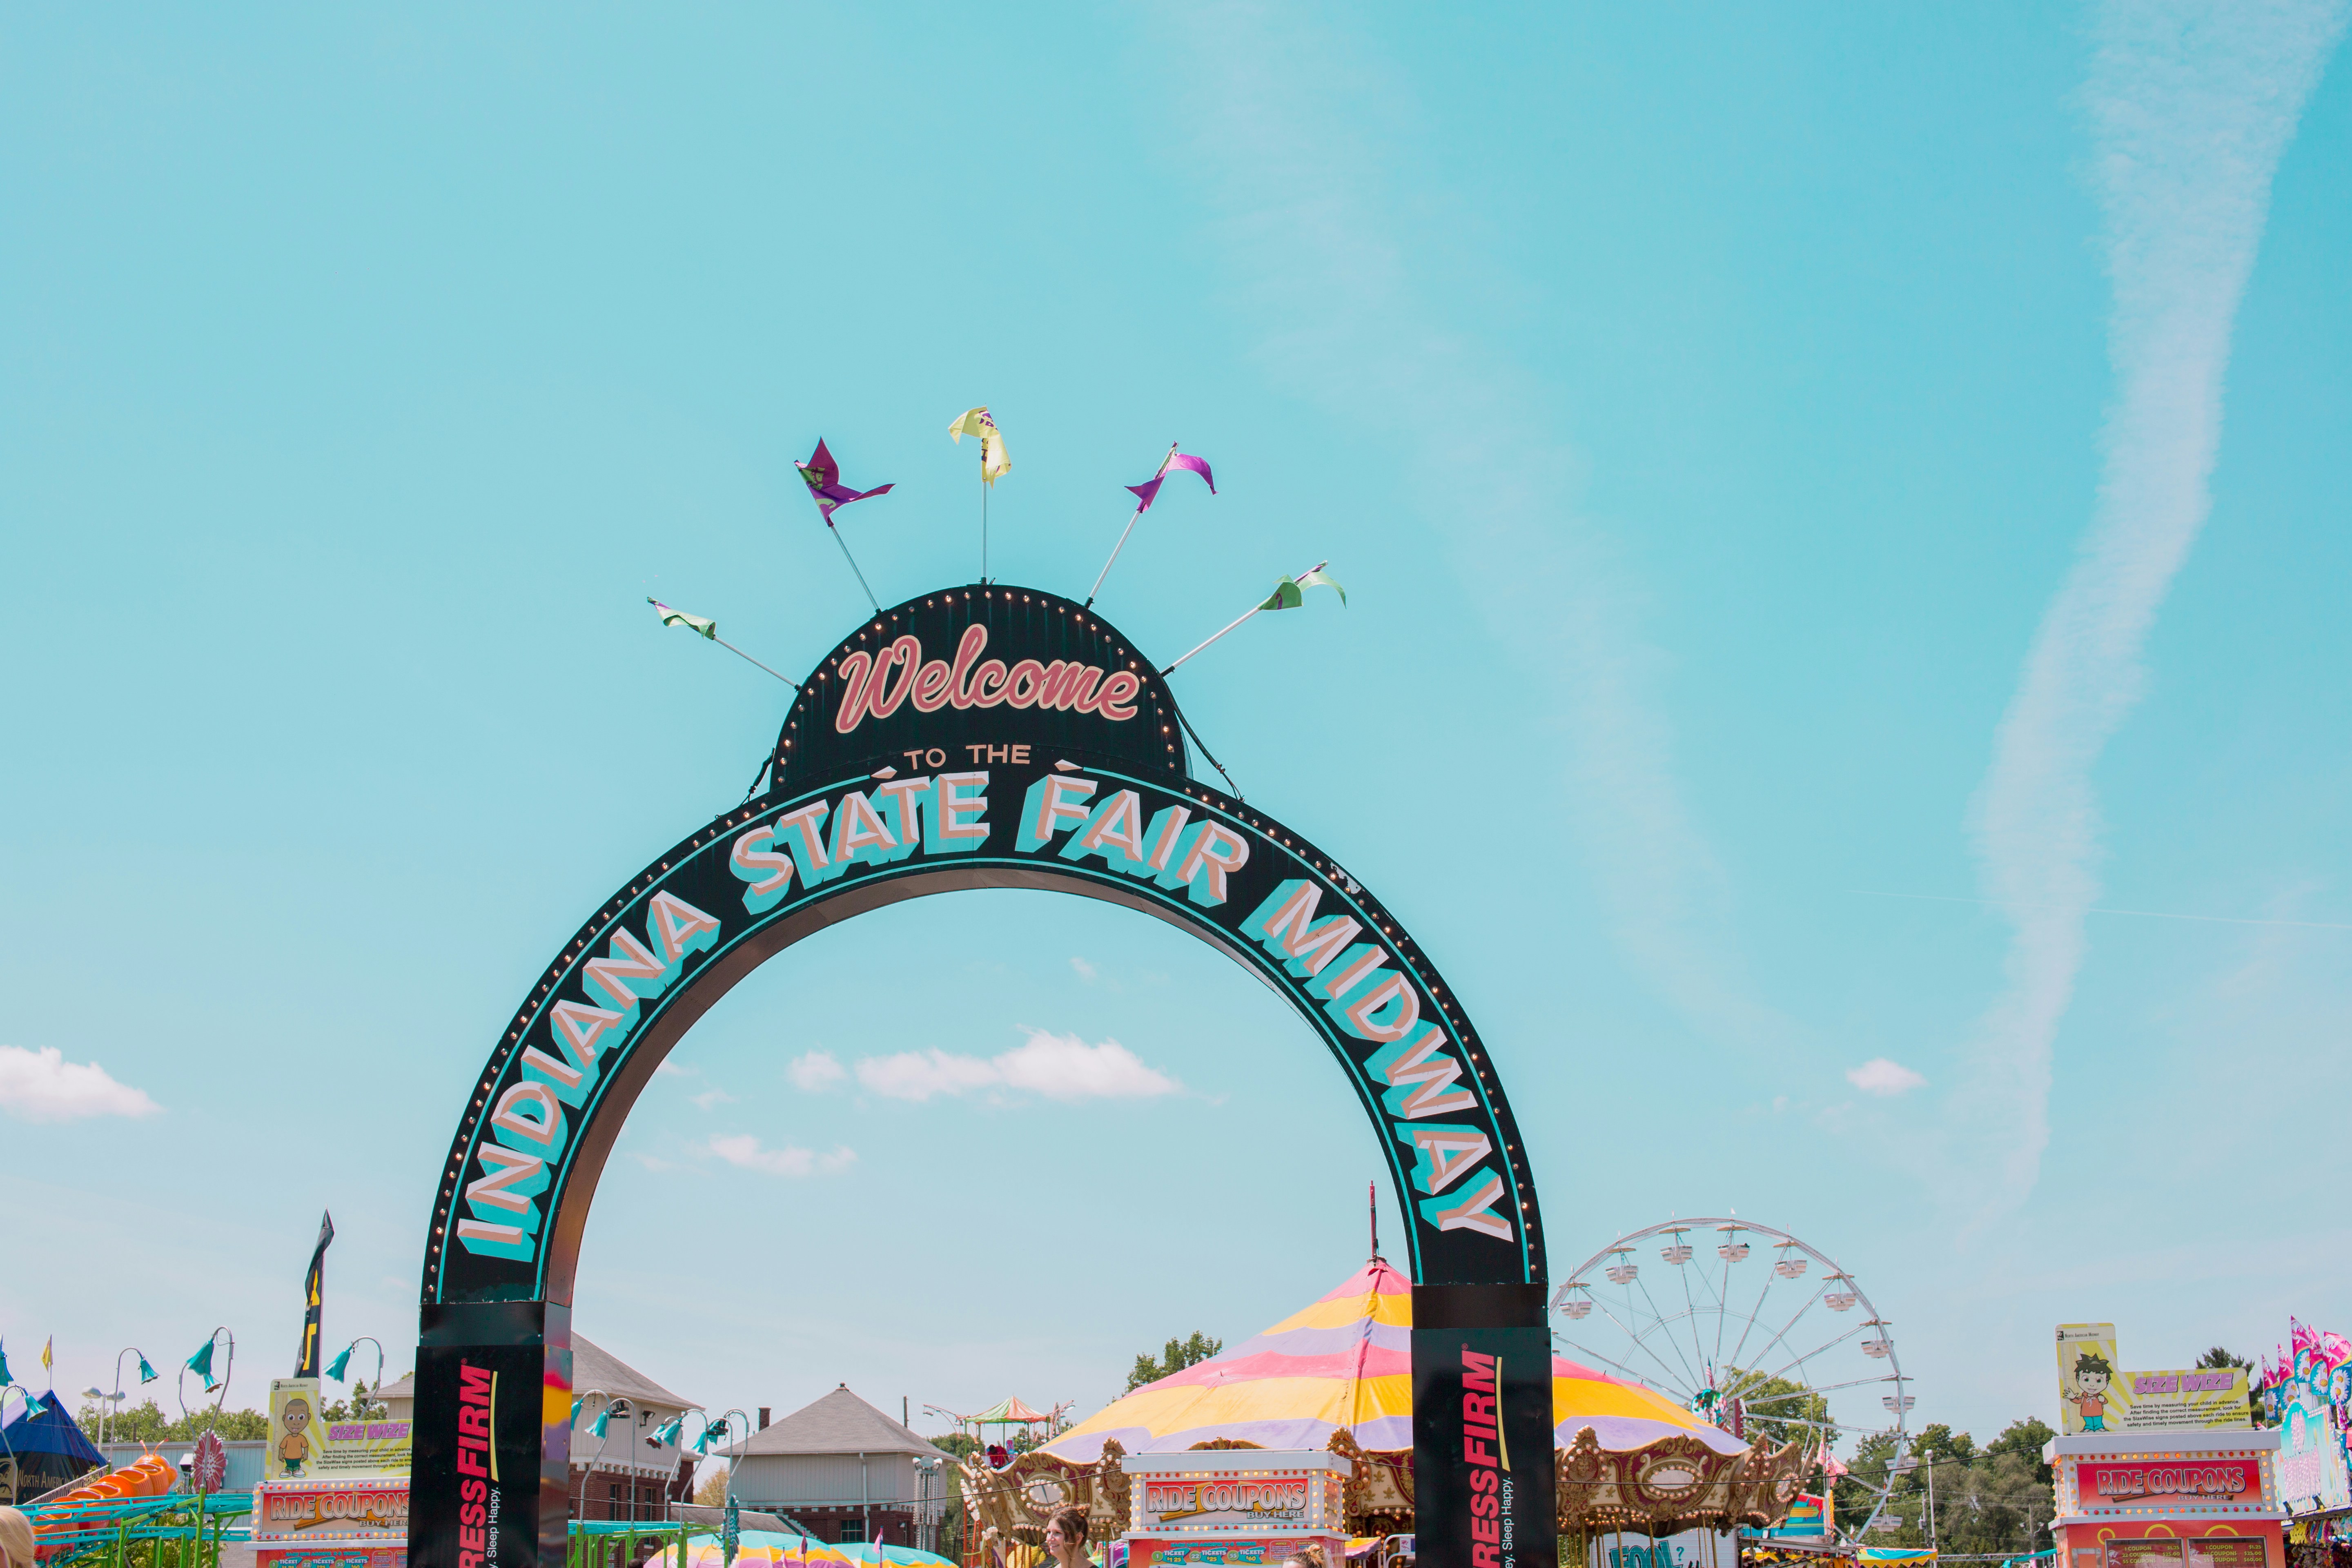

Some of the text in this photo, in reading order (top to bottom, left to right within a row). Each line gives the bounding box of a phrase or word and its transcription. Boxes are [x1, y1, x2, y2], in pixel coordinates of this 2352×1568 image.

[835, 623, 1140, 734] Welcome
[904, 744, 1031, 770] TO THE
[457, 770, 1514, 1263] INDIANA STATE FAIR MIDWAY
[2133, 1373, 2234, 1394] SIZE WIZE
[327, 1423, 410, 1441] SIZE WIZE
[18, 1470, 71, 1489] NORTH AMERIC
[2097, 1468, 2246, 1495] RIDE COUPONS
[271, 1492, 409, 1520] RIDE COUPONS
[488, 1487, 501, 1523] Happy.
[1147, 1486, 1197, 1512] RIDE
[1200, 1483, 1306, 1511] COUPONS
[1501, 1477, 1513, 1515] Happy.
[487, 1527, 499, 1557] Sleep
[1502, 1519, 1515, 1550] Sleep
